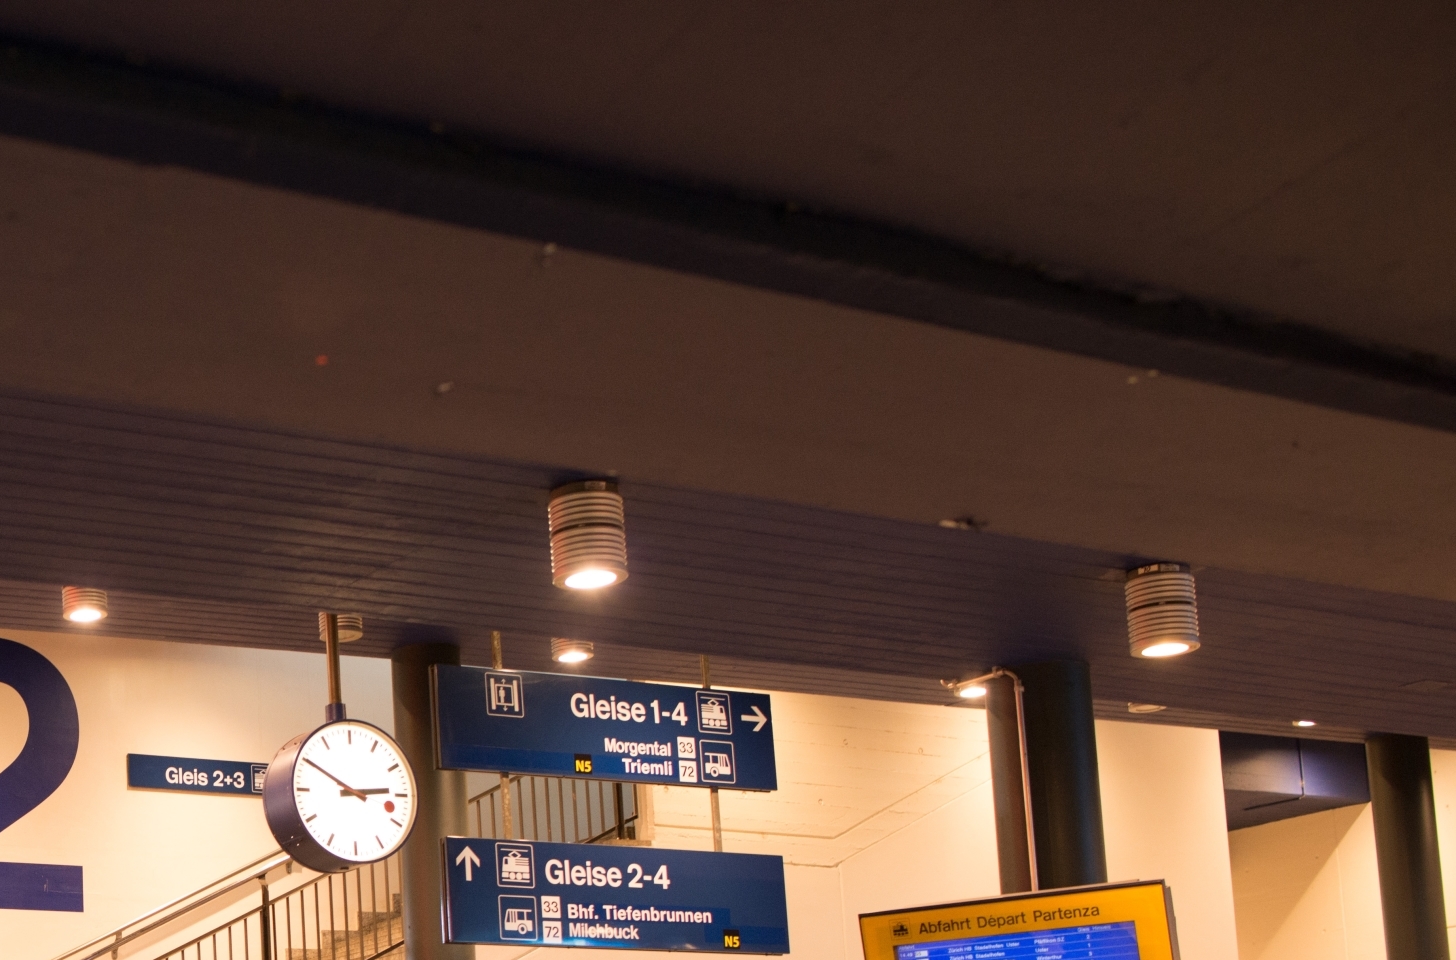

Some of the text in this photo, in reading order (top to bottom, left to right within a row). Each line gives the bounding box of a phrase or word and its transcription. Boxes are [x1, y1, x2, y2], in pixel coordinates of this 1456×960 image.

[570, 693, 688, 726] Gleise 1-4
[604, 738, 693, 757] Morgental 33
[575, 760, 592, 773] N5
[622, 758, 695, 778] Triemli 72
[165, 767, 245, 788] Gleis 2+3
[545, 859, 670, 889] Gleise 2-4
[544, 901, 712, 923] 33 Bhf. Tiefenbrunnen
[919, 905, 1100, 934] Abfahrt Départ Partenza
[545, 923, 640, 940] 72 Milchbuck
[725, 935, 740, 948] N5
